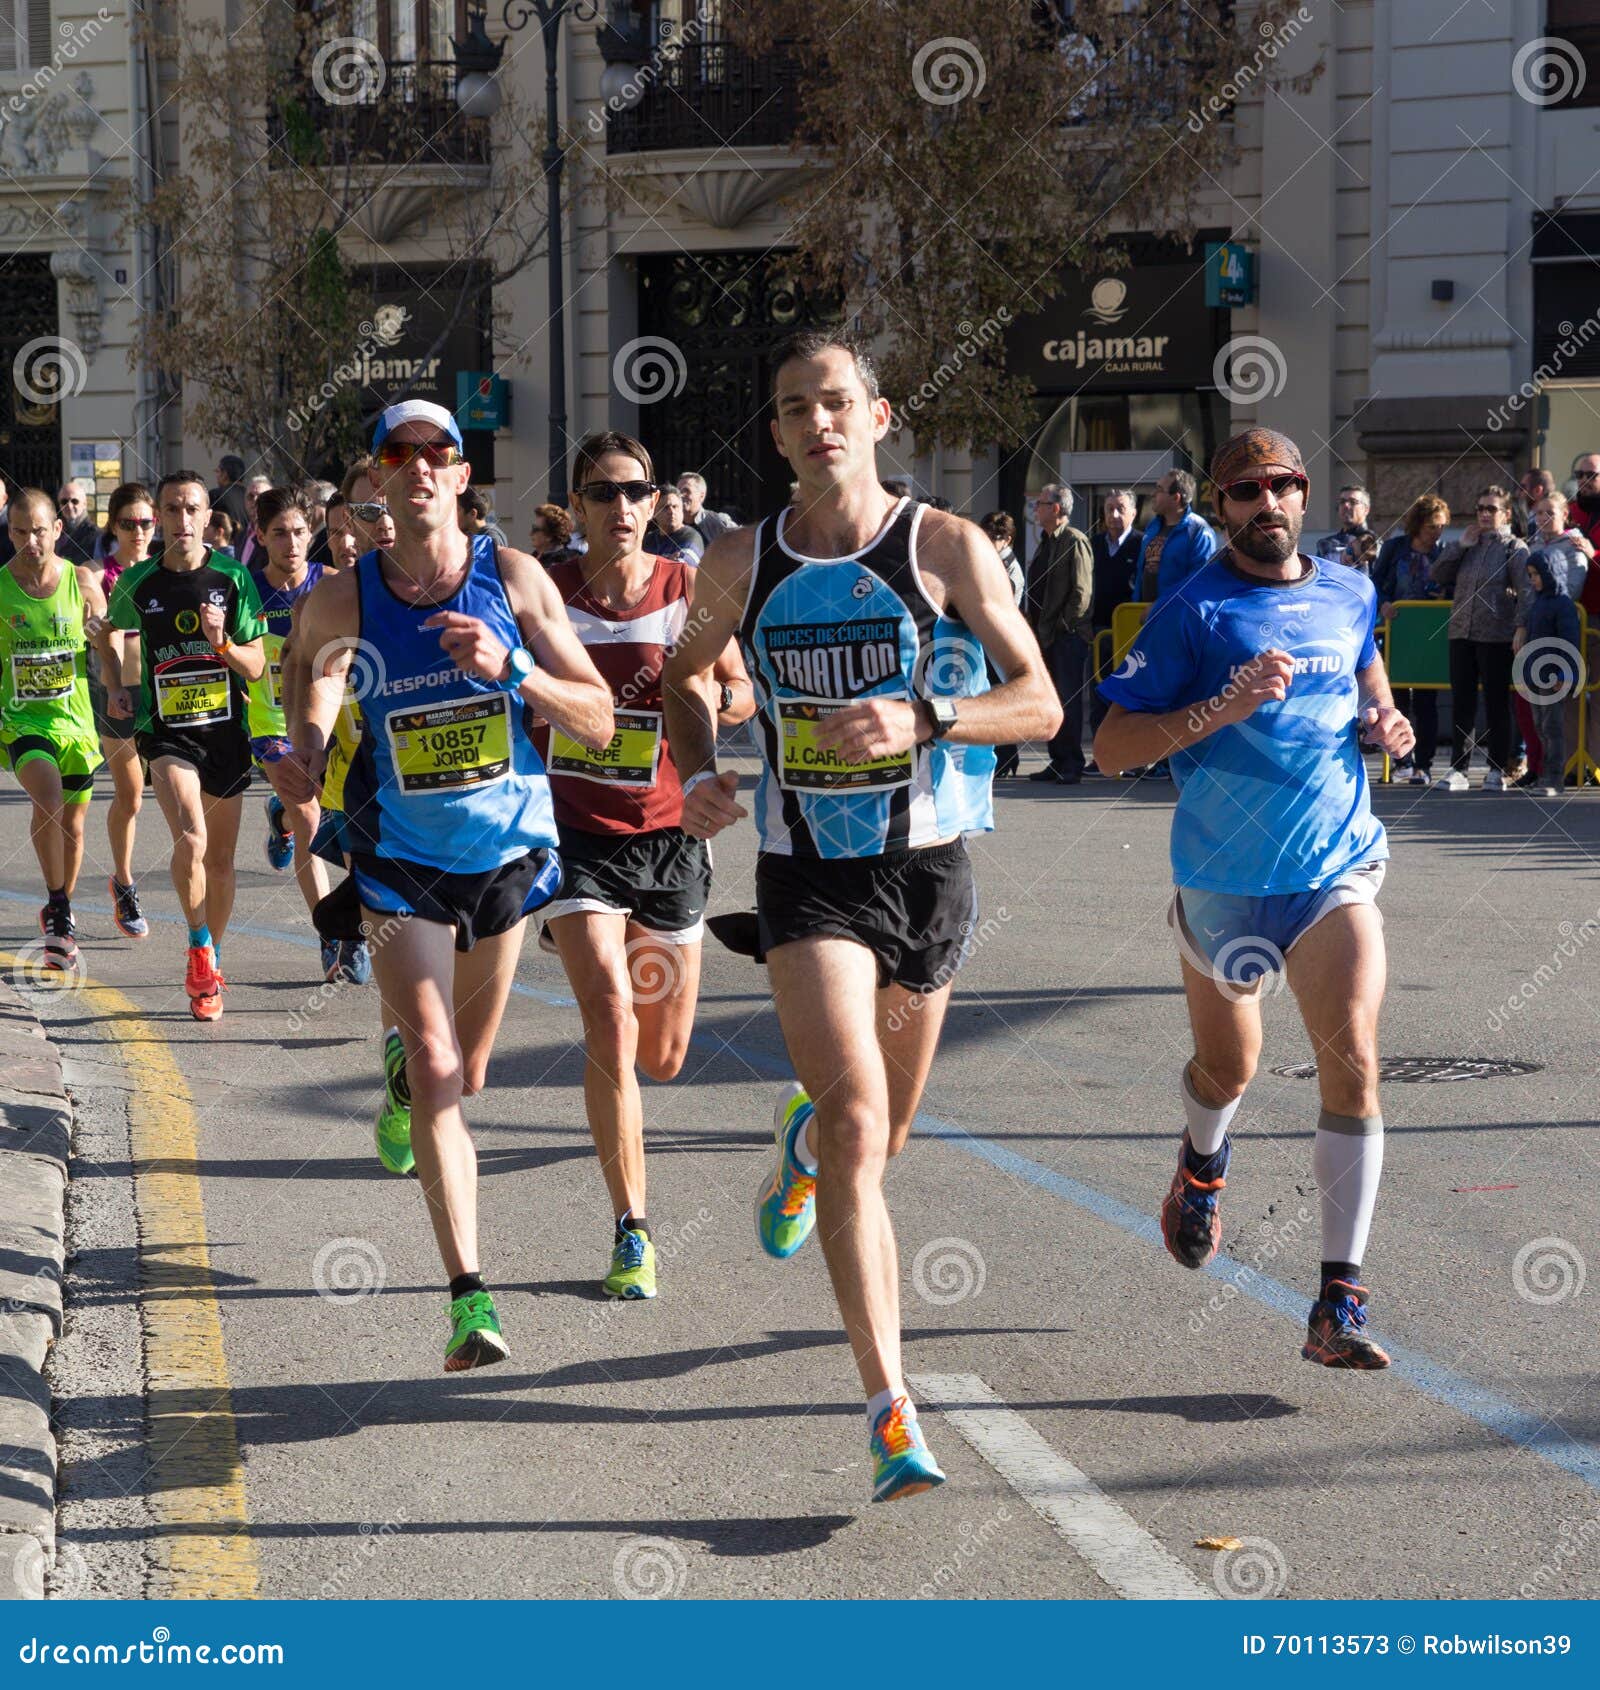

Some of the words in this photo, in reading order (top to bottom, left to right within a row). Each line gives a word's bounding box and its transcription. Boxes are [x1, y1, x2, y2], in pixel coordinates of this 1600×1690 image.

[1043, 330, 1169, 369] cajamar
[349, 353, 441, 388] ajamar
[1105, 362, 1130, 372] CAJA
[1132, 362, 1164, 371] RURAL
[769, 628, 816, 647] HOCES
[817, 626, 836, 644] DE
[839, 622, 895, 642] CUENCA
[154, 644, 180, 662] VIA
[180, 640, 217, 655] VER
[770, 641, 897, 699] TRIATLÓN
[182, 687, 207, 700] 374
[175, 699, 215, 711] MANUEL
[417, 724, 487, 753] 10857
[432, 747, 480, 767] JORDI
[586, 746, 621, 762] PEPE
[785, 746, 799, 763] J.
